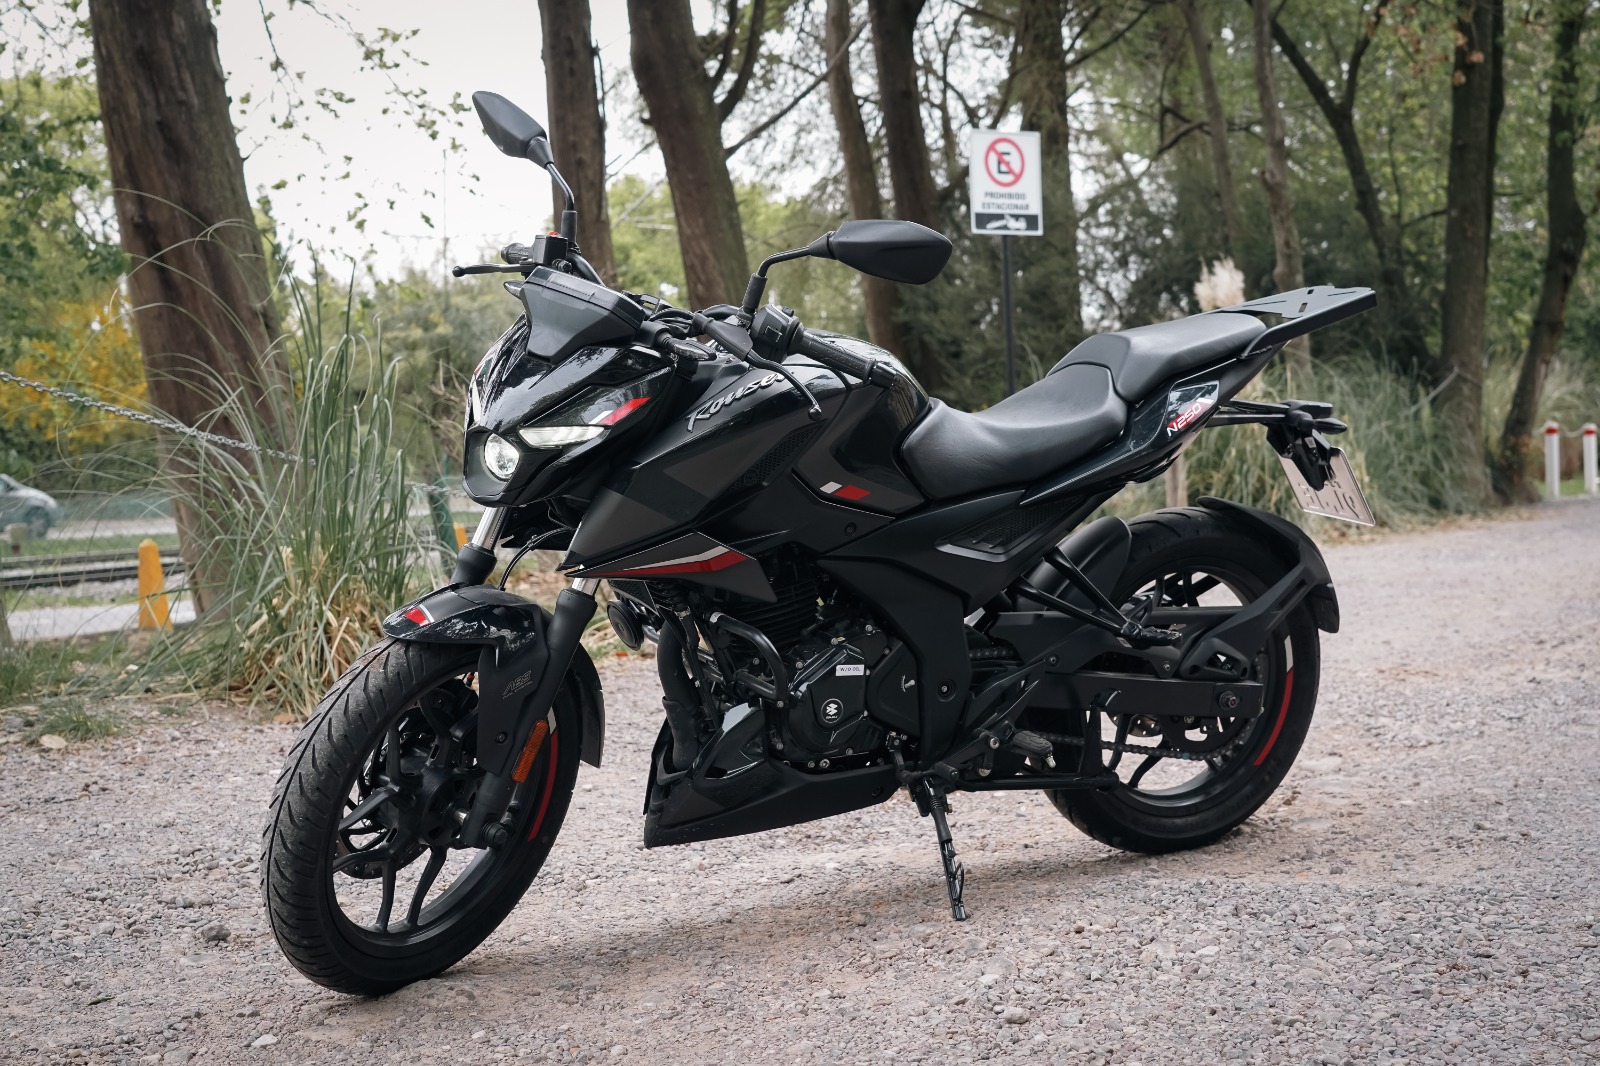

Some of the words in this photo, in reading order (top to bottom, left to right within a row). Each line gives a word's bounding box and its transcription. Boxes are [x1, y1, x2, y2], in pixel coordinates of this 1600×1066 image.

[984, 191, 1027, 200] PROHIBIDO
[981, 202, 1029, 211] ESTACIONAR
[1166, 402, 1202, 437] N250
